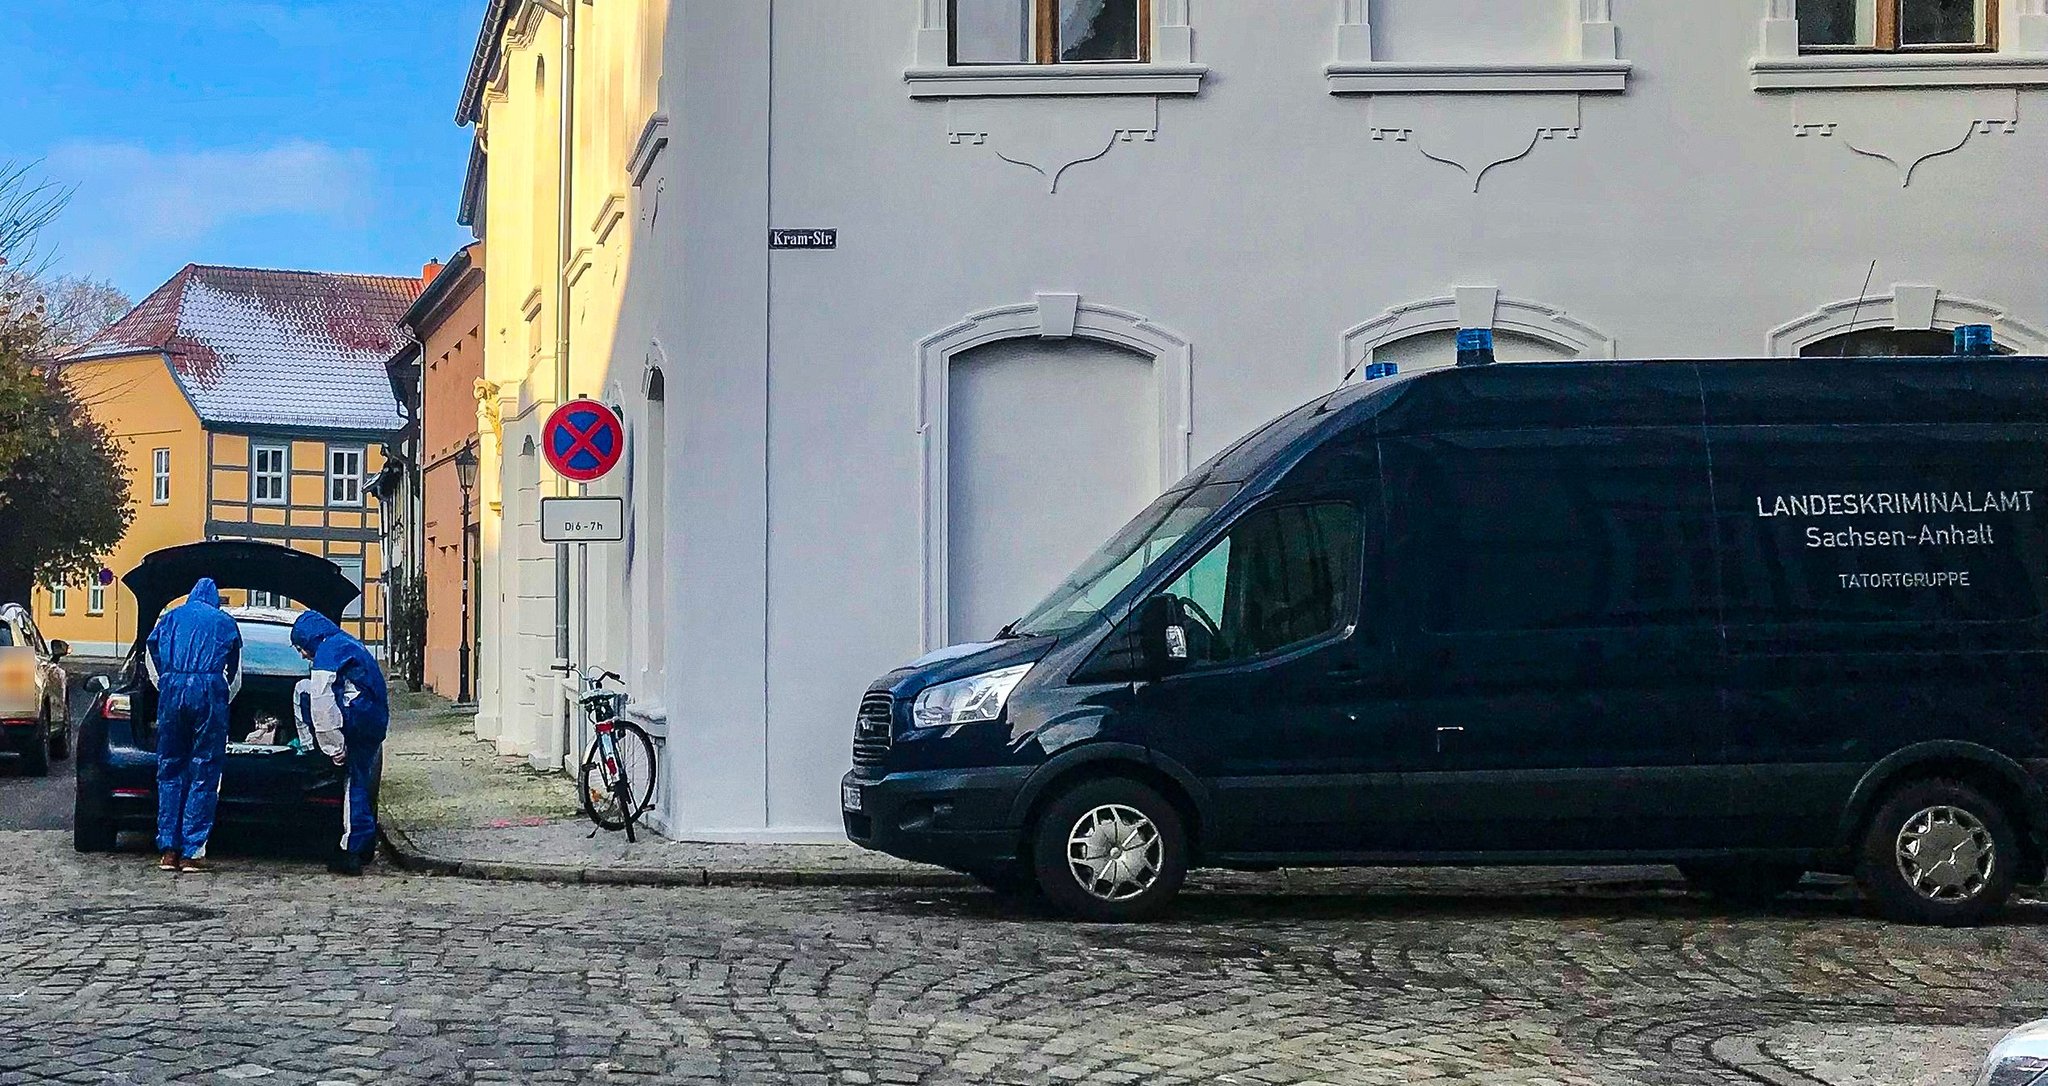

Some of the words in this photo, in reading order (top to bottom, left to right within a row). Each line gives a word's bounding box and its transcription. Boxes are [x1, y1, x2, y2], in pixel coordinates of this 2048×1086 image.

[773, 230, 833, 246] Kram-Str.
[1756, 490, 2034, 517] LANDESKRIMINALAMT
[1805, 523, 1995, 548] Sachsen-Anhalt
[1838, 571, 1971, 588] TATORTGRUPPE
